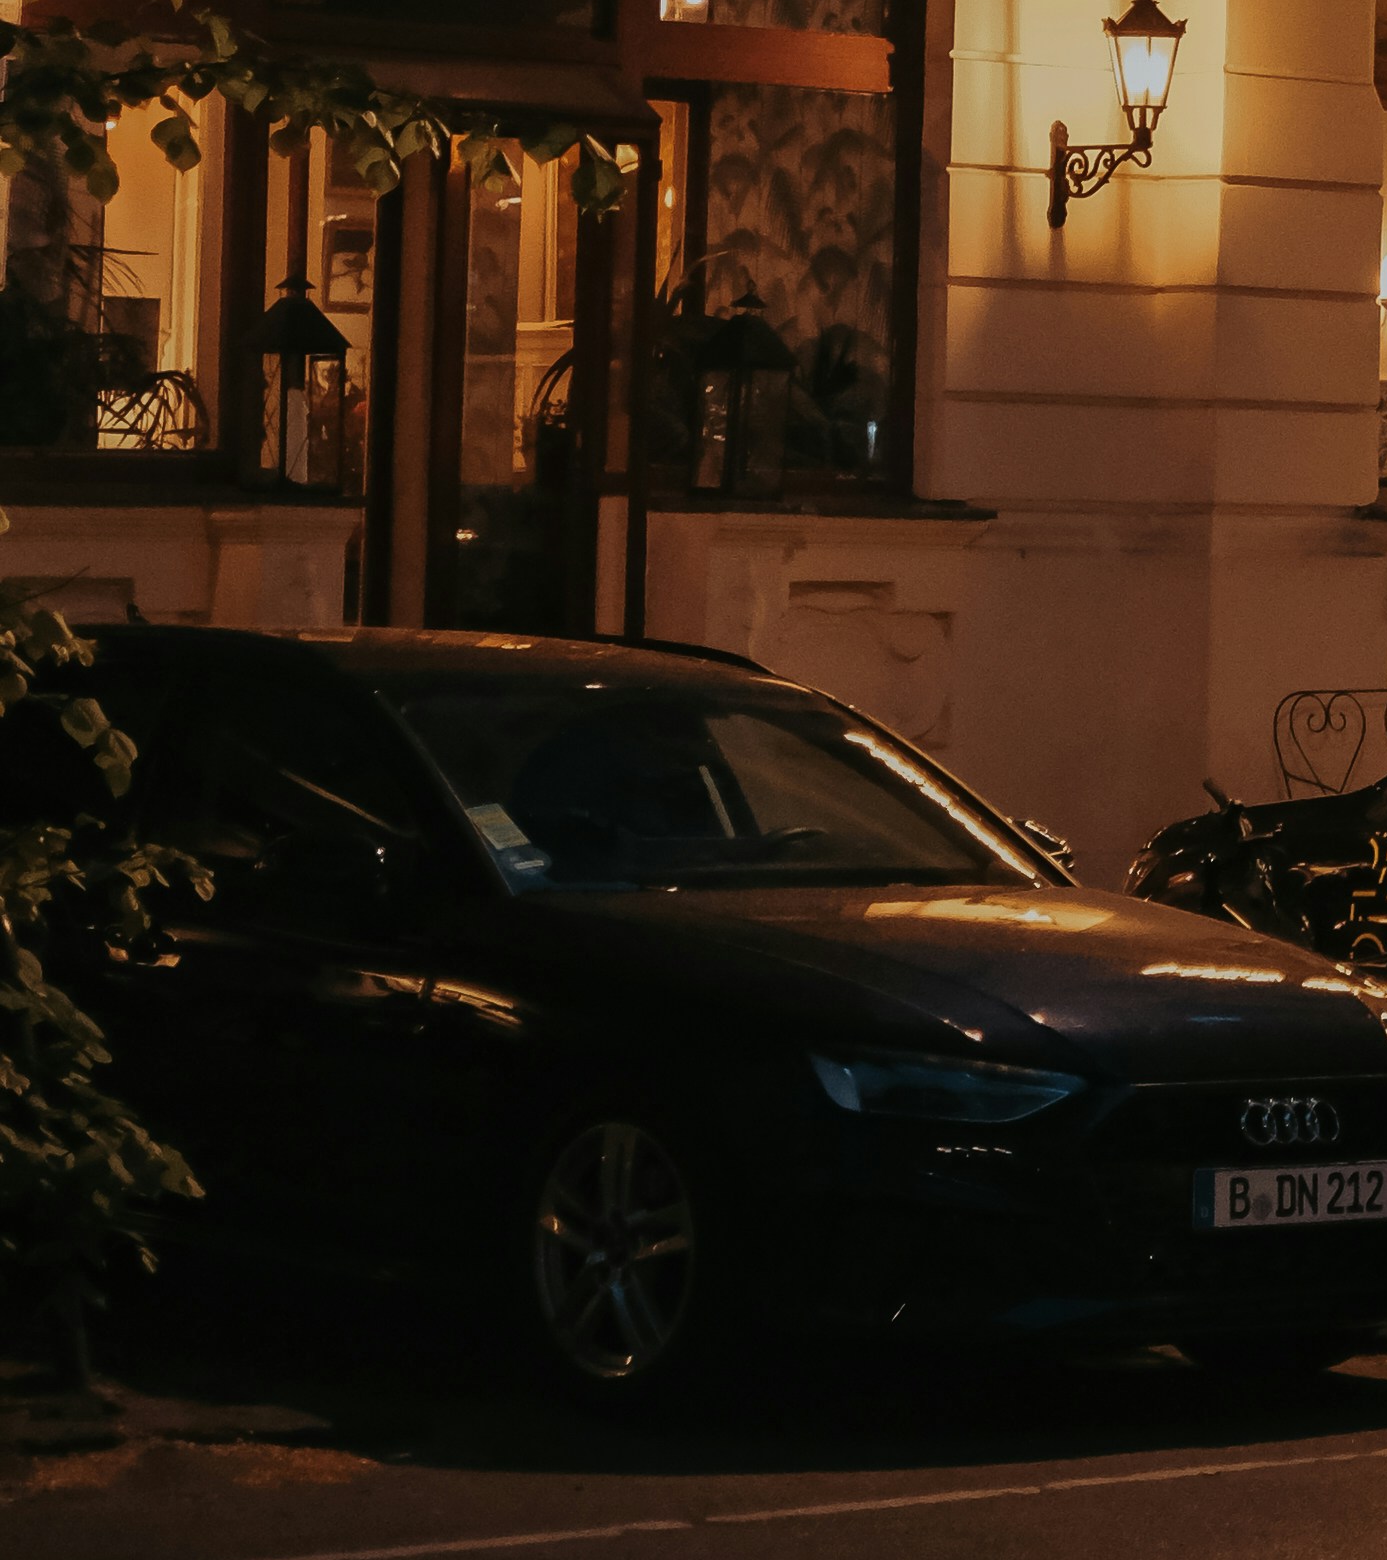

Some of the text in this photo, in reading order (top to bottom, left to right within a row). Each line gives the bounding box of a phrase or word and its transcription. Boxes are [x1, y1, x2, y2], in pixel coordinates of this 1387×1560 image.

[1229, 1177, 1250, 1219] B
[1275, 1172, 1318, 1217] DN
[1326, 1169, 1384, 1214] 212
